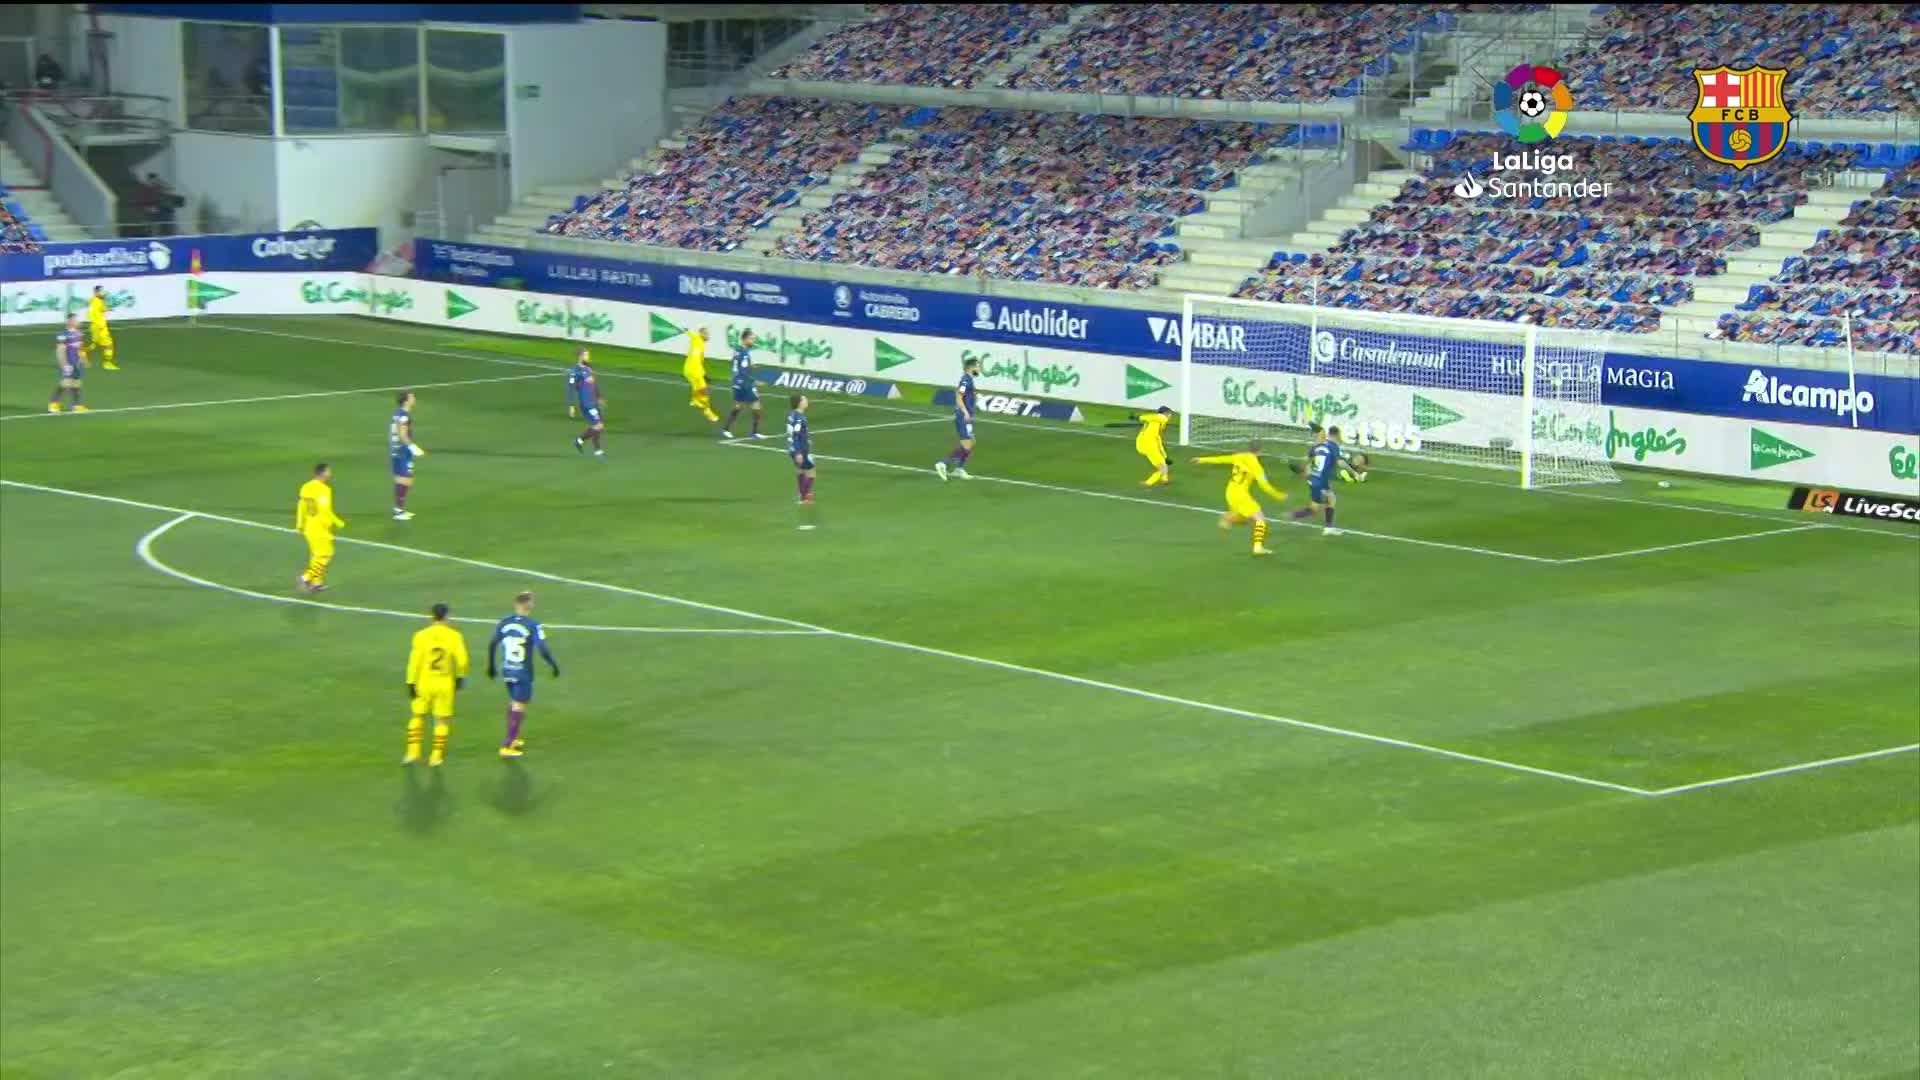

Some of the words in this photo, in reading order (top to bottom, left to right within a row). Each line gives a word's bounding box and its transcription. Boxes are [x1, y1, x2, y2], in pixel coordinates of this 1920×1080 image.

[997, 306, 1088, 340] Autolíder
[774, 371, 845, 393] Allianz
[1742, 369, 1875, 417] Alcampo
[1323, 414, 1421, 452] et365
[1604, 409, 1687, 462] Inglés
[1888, 444, 1918, 480] El
[430, 647, 448, 670] 2
[502, 636, 526, 663] 15
